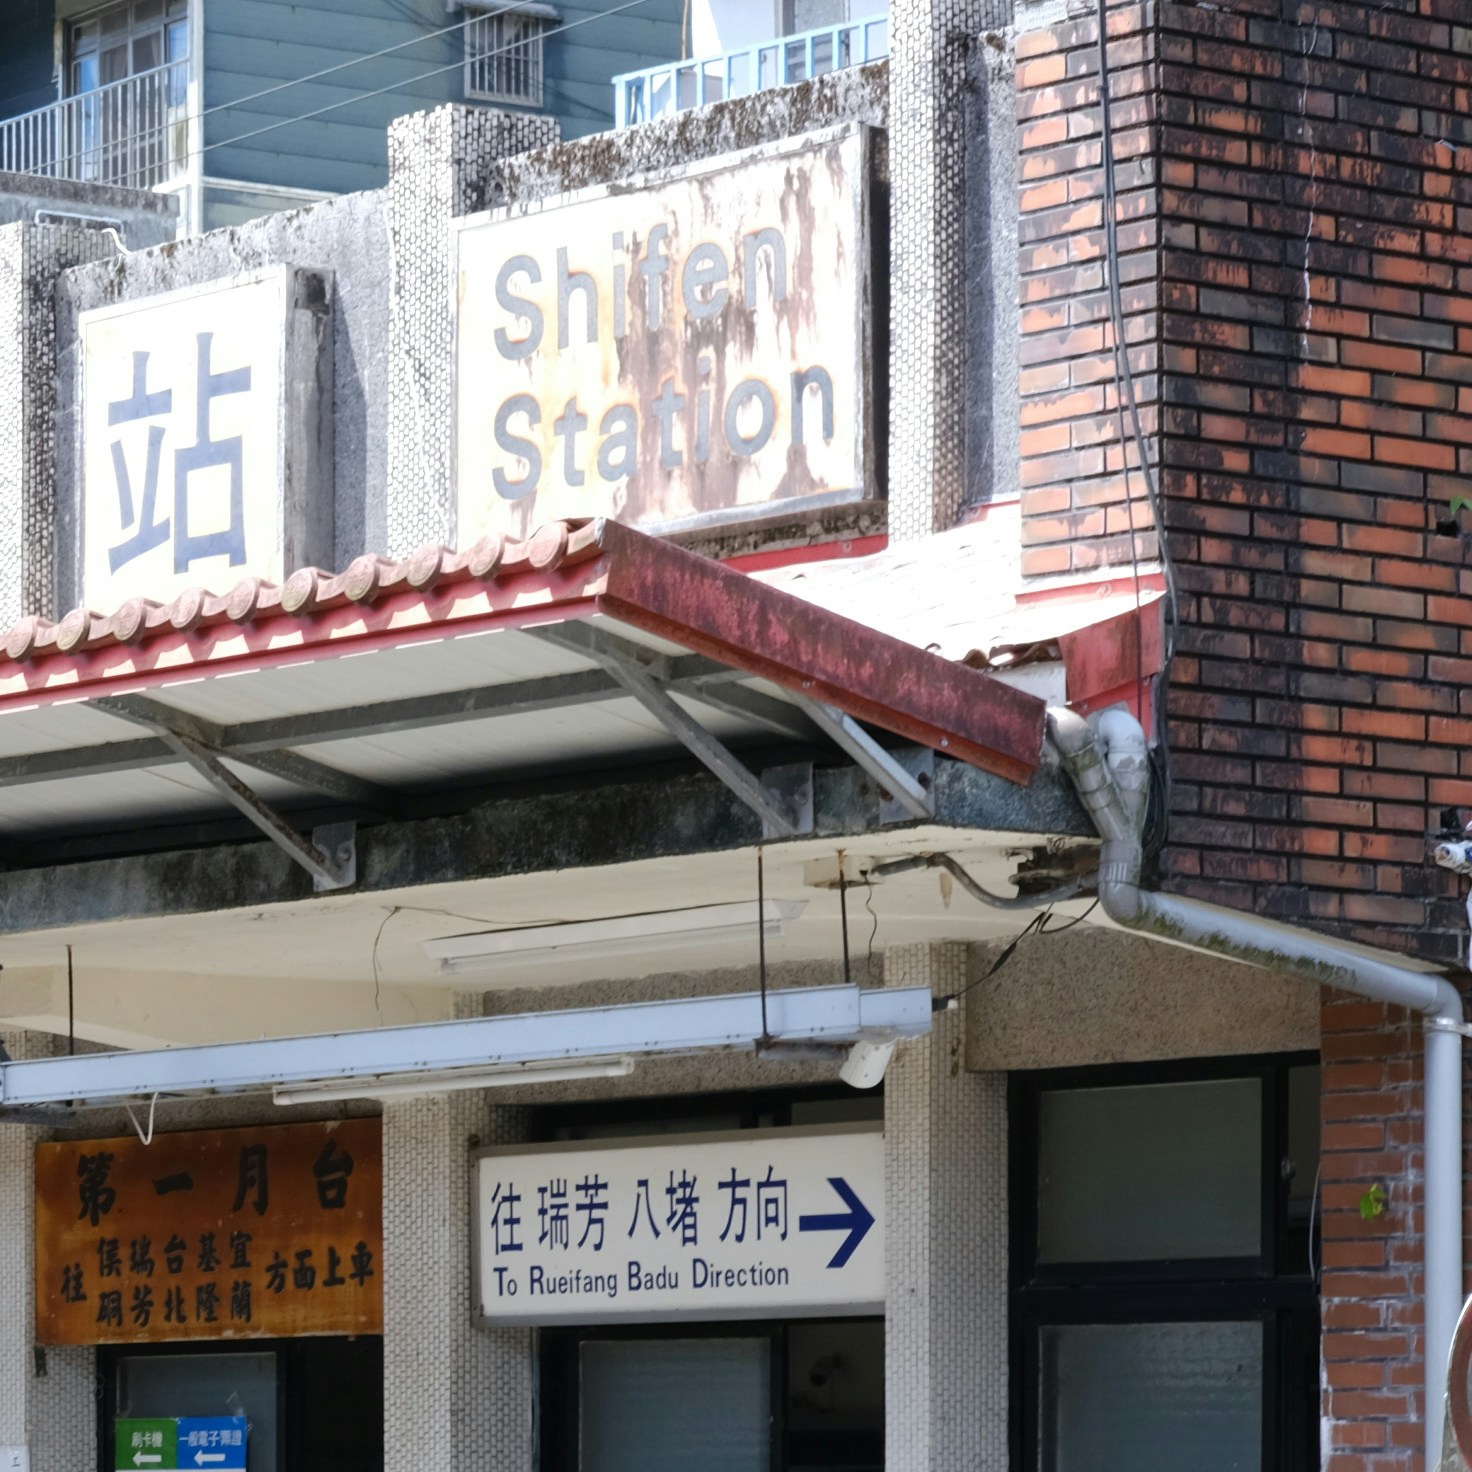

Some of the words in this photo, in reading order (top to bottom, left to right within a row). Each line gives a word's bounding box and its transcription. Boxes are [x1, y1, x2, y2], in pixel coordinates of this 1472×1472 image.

[494, 223, 786, 361] Shifen
[492, 358, 834, 501] Station
[493, 1266, 519, 1297] To
[529, 1263, 619, 1299] Rueifang
[627, 1260, 680, 1291] Badu
[692, 1257, 790, 1289] Direction
